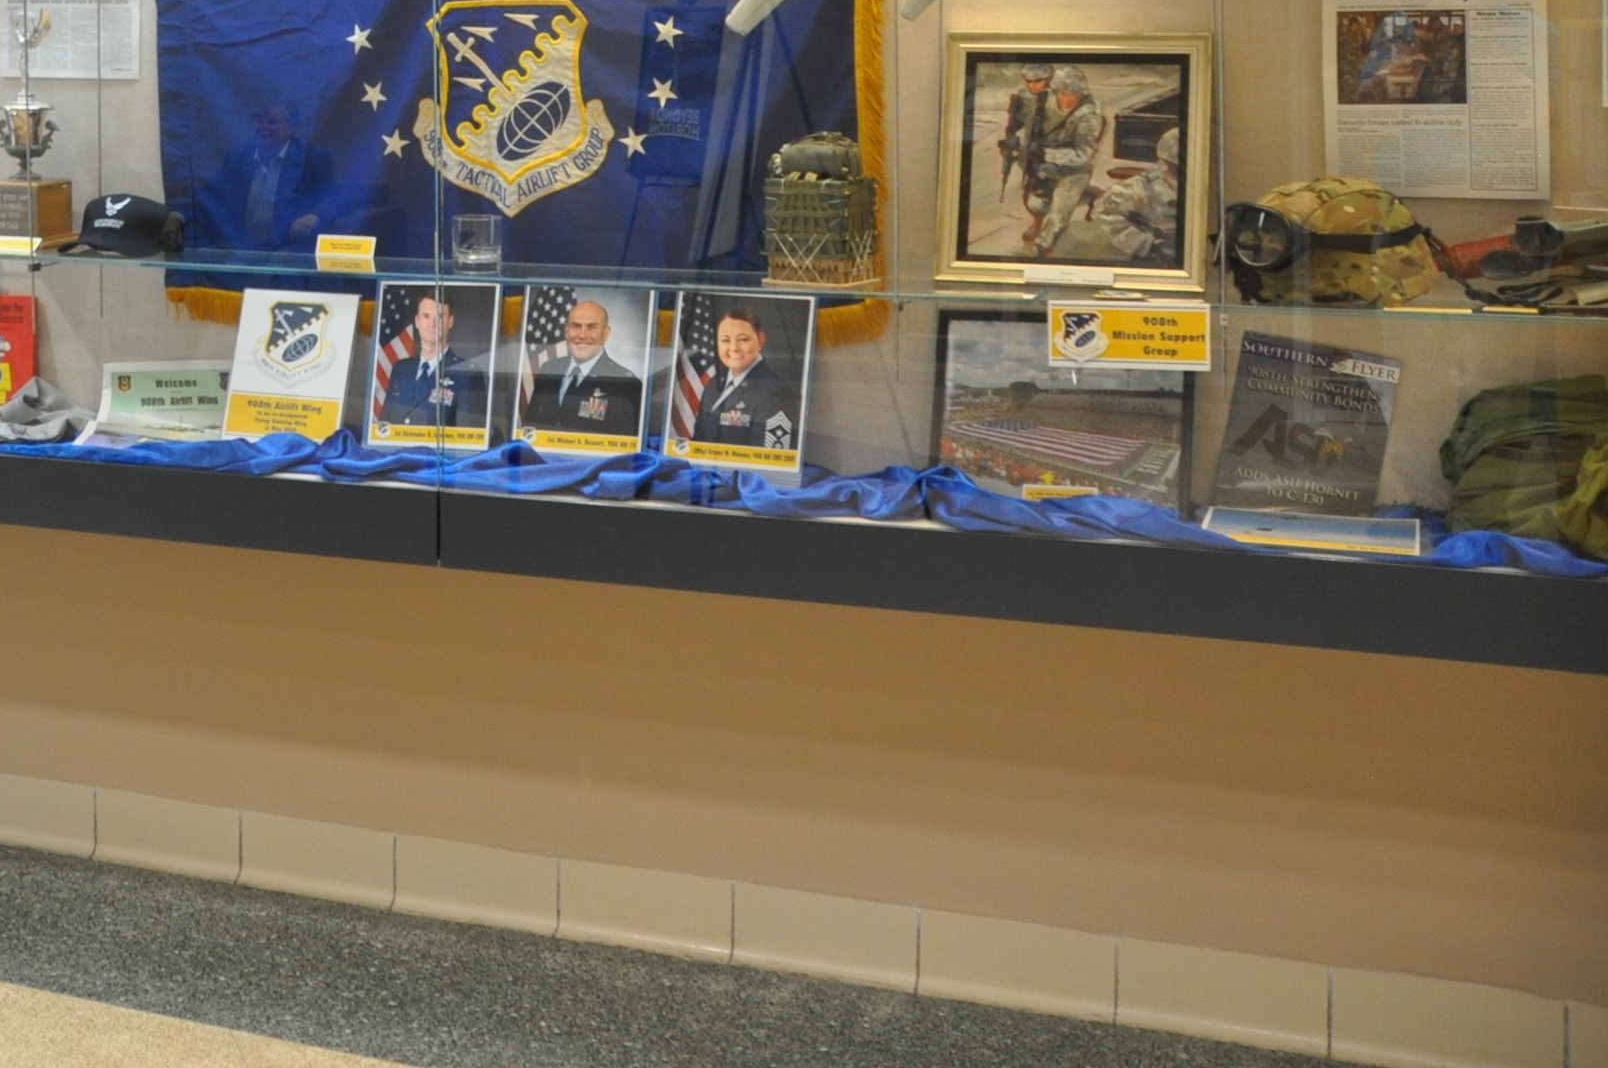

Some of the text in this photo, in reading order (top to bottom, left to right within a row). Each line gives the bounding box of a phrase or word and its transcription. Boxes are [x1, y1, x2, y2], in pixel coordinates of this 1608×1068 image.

[1337, 119, 1366, 127] Security
[1447, 119, 1463, 128] duty
[455, 162, 511, 208] TACTICAL
[516, 162, 572, 202] AIRLIFT
[573, 127, 606, 171] GROUP
[1143, 316, 1178, 327] 908th
[1112, 331, 1206, 344] Mission Support
[1143, 346, 1178, 357] Group
[1243, 340, 1397, 381] SOUTHERN FLYER
[155, 379, 198, 389] Welcome
[1248, 365, 1383, 400] 908TH STRENGTHENS
[140, 395, 219, 407] 908th Airlift Wing
[1247, 379, 1380, 414] COMMUNITY BONDS
[248, 400, 322, 415] 908th Airlift Wing
[1234, 466, 1361, 501] ADDS ASU HORNET
[1266, 486, 1325, 505] TO C-130
